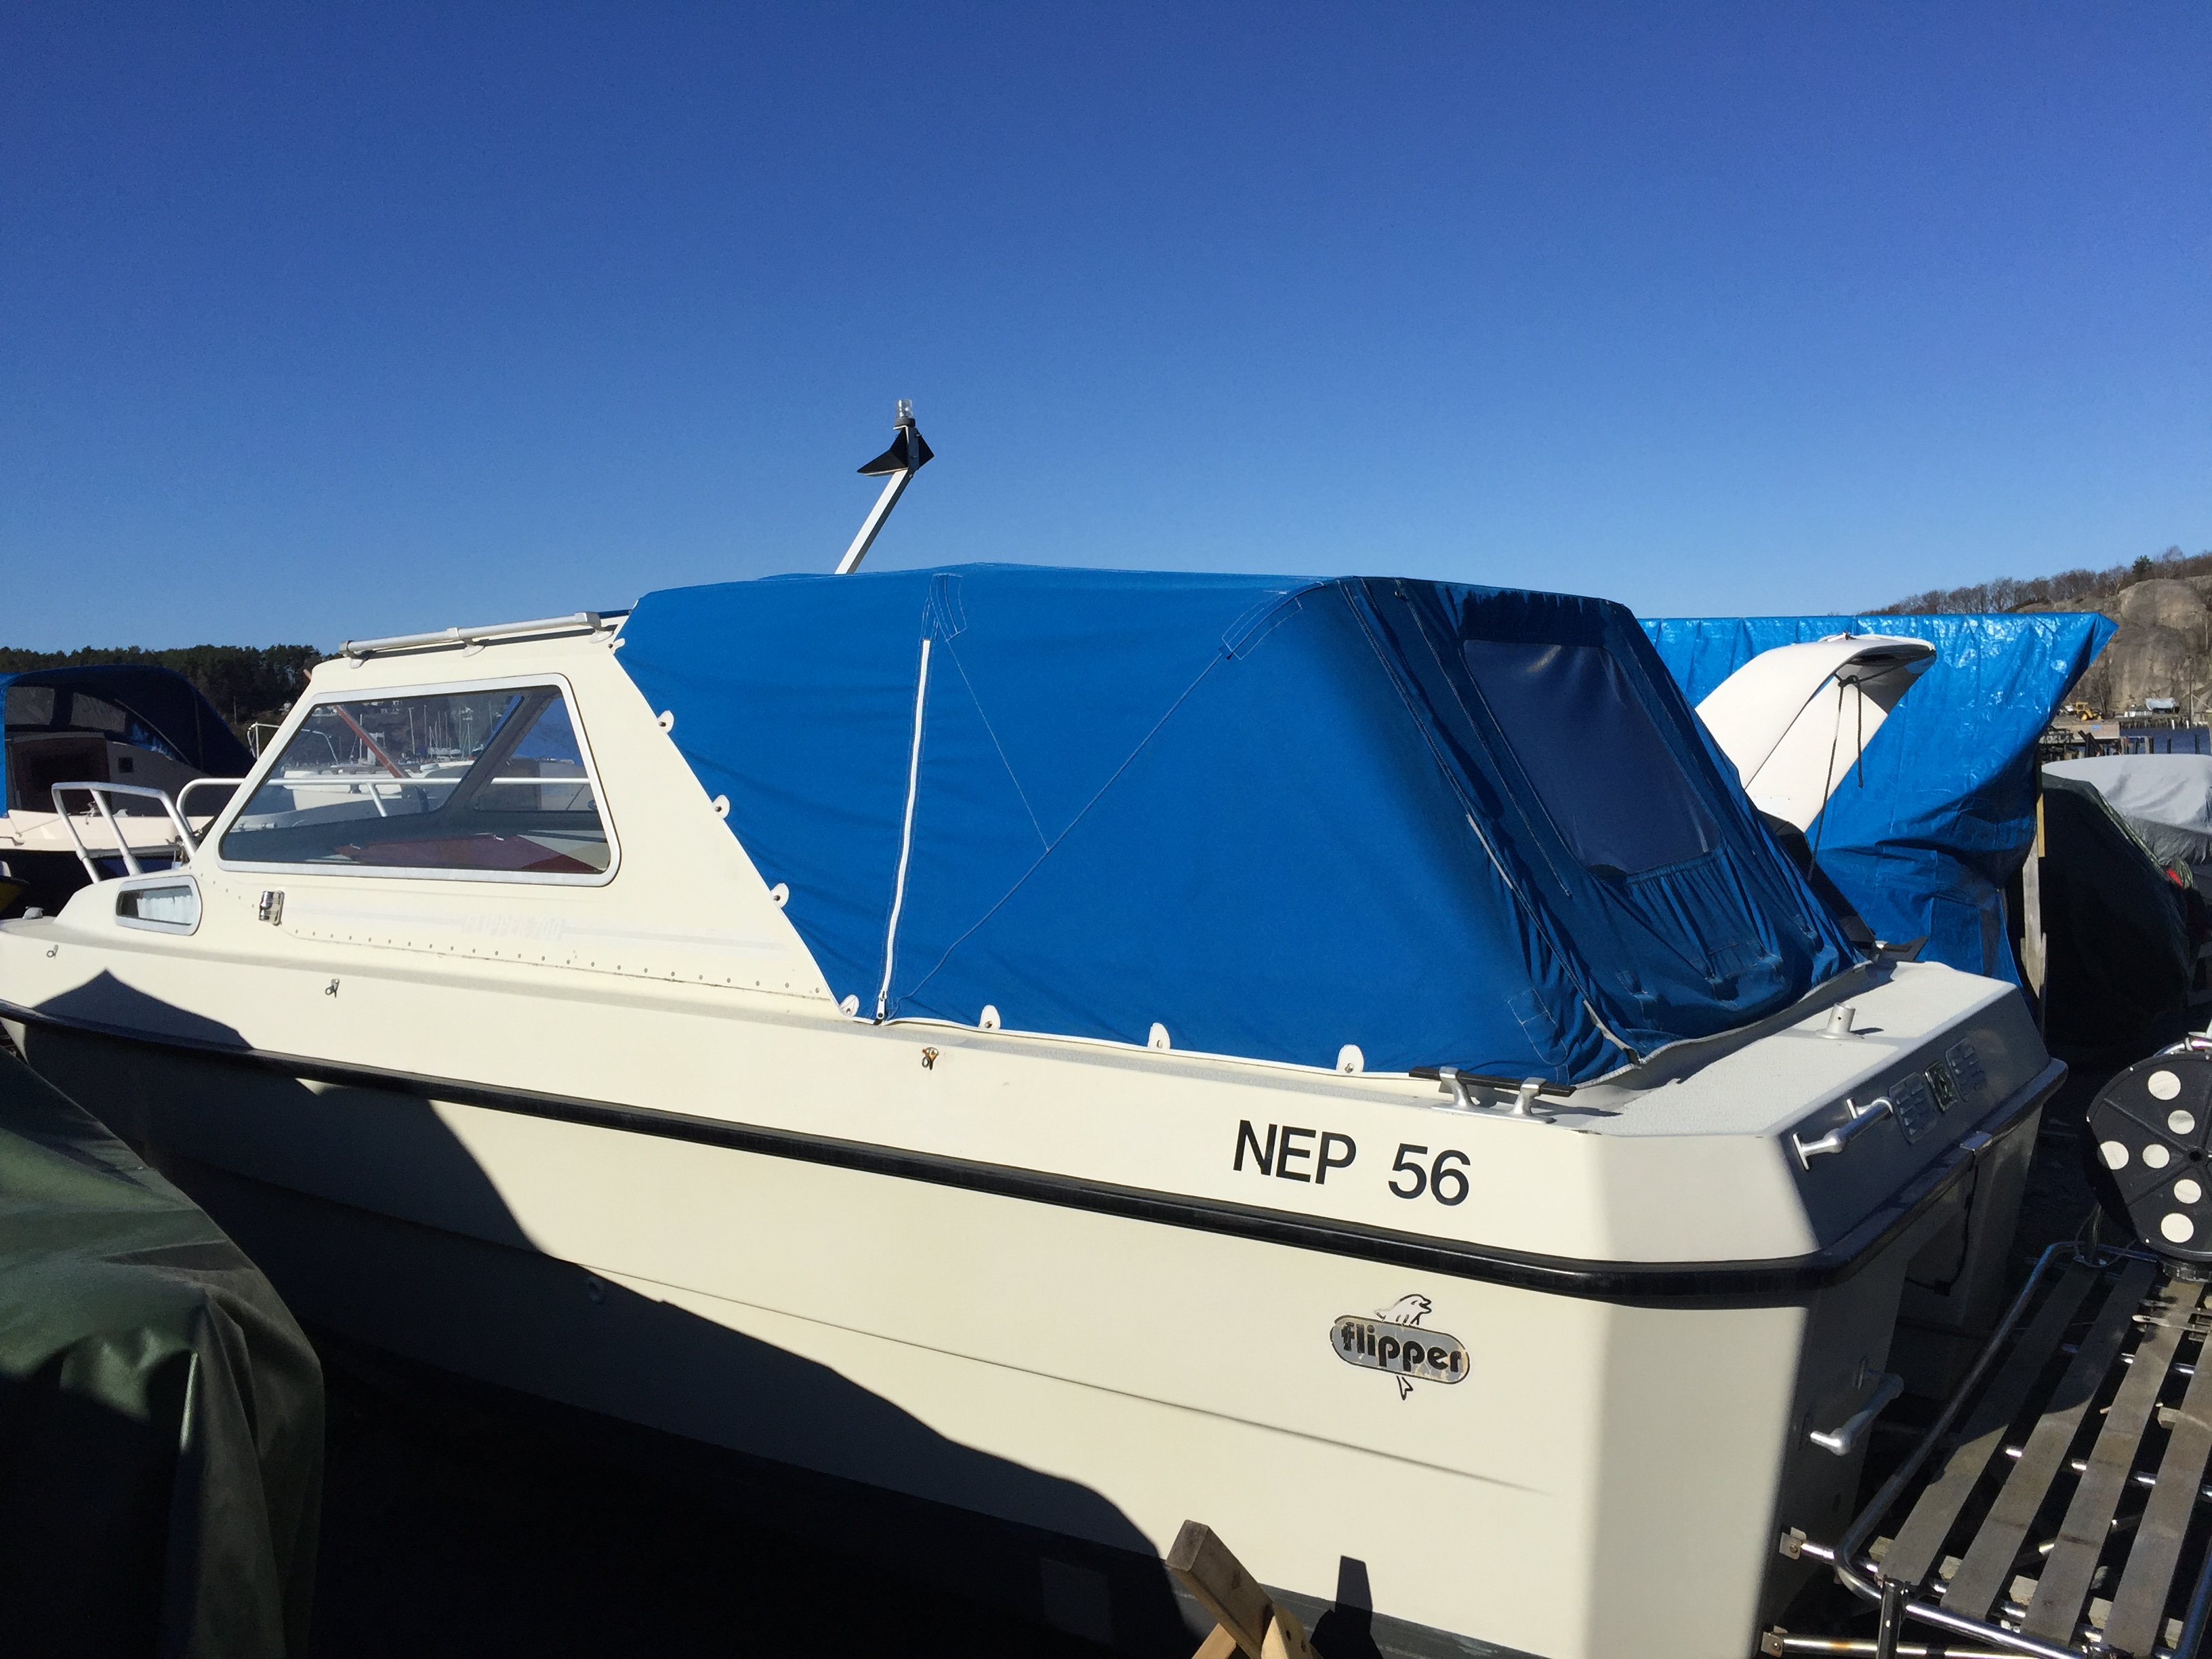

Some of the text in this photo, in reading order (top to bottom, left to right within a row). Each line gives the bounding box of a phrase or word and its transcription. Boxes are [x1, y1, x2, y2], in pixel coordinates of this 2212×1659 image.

[463, 914, 529, 939] FLIPPER
[1233, 1120, 1471, 1206] NEP 56
[1340, 1321, 1462, 1373] flipper
